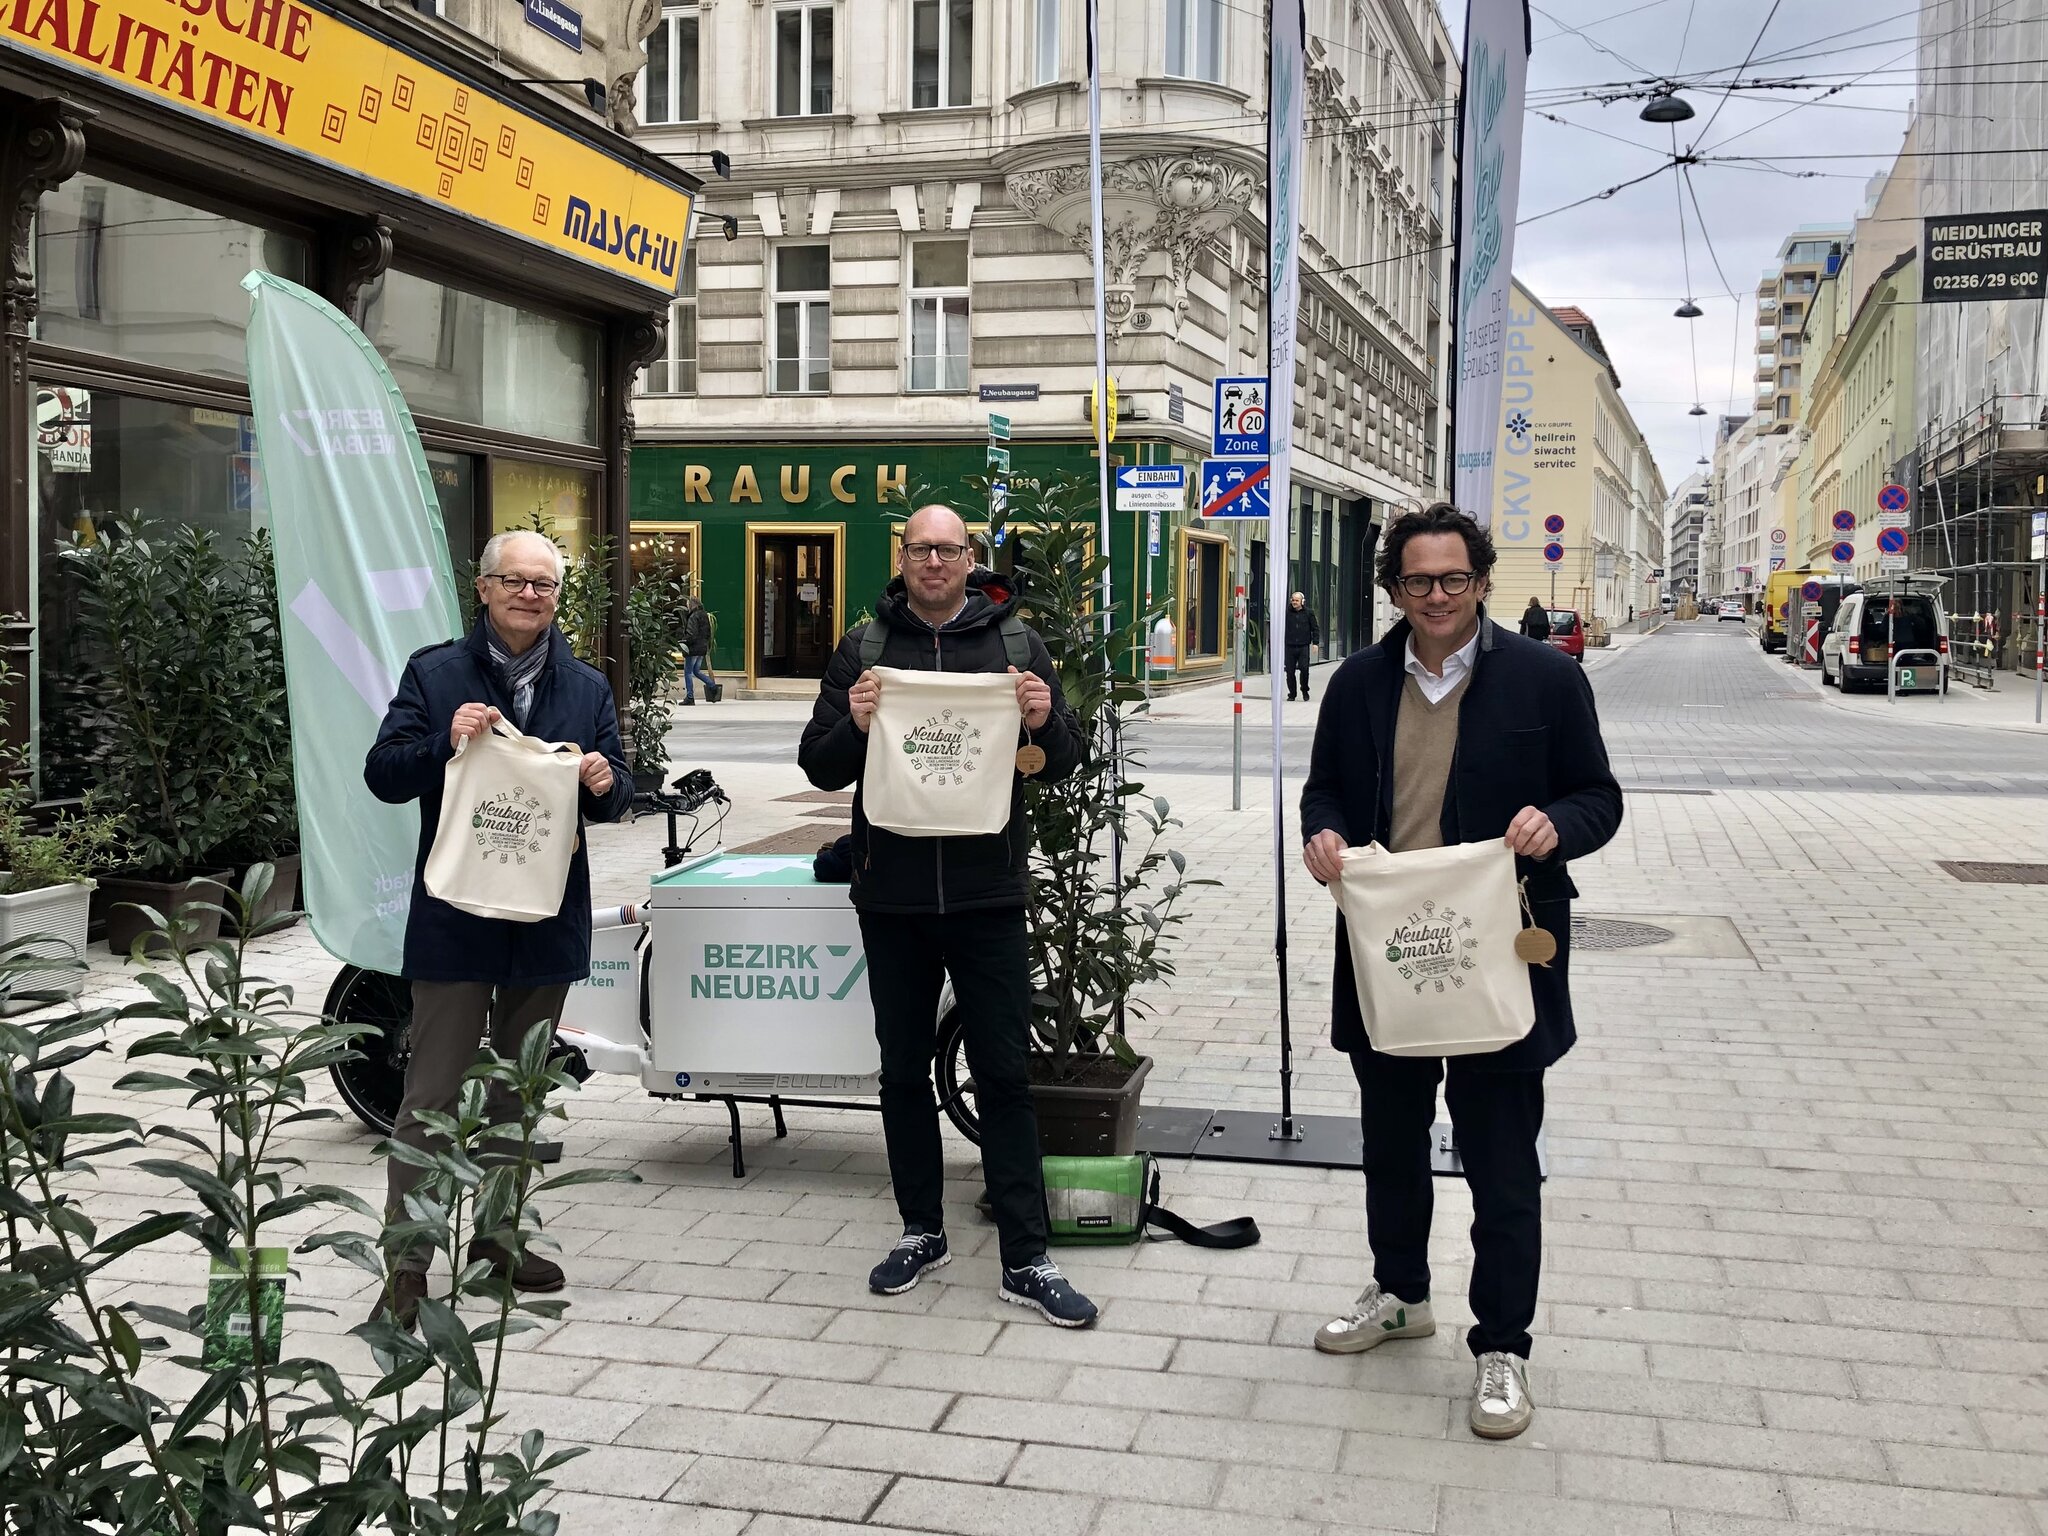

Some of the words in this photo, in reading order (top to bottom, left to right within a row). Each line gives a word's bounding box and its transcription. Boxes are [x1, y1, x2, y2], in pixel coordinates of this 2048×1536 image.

[0, 0, 294, 135] IALITÄTEN
[1932, 221, 2042, 241] MEIDLINGER
[1931, 241, 2042, 261] GERÜSTBAU
[1933, 273, 2006, 290] 02236/29
[1136, 312, 1146, 324] 13
[1504, 307, 1536, 456] GRUPPE
[1246, 416, 1262, 430] 20
[1225, 438, 1259, 451] Zone
[1534, 432, 1576, 442] hellrein
[1534, 445, 1576, 455] siwacht
[1534, 459, 1576, 469] servitec
[684, 464, 907, 504] RAUCH
[1138, 472, 1176, 482] EINBAHN
[1501, 470, 1532, 541] CKV
[1775, 532, 1783, 540] 30
[926, 716, 938, 727] 11
[904, 726, 963, 743] Neubau
[916, 741, 962, 756] markt
[496, 792, 509, 802] 11
[474, 800, 532, 823] Neubau
[481, 819, 530, 835] markt
[1407, 912, 1421, 925] 11
[1385, 925, 1451, 946] Neubau
[704, 944, 819, 969] BEZIRK
[1387, 950, 1401, 958] DER
[1401, 939, 1454, 959] markt
[691, 974, 820, 1000] NEUBAU
